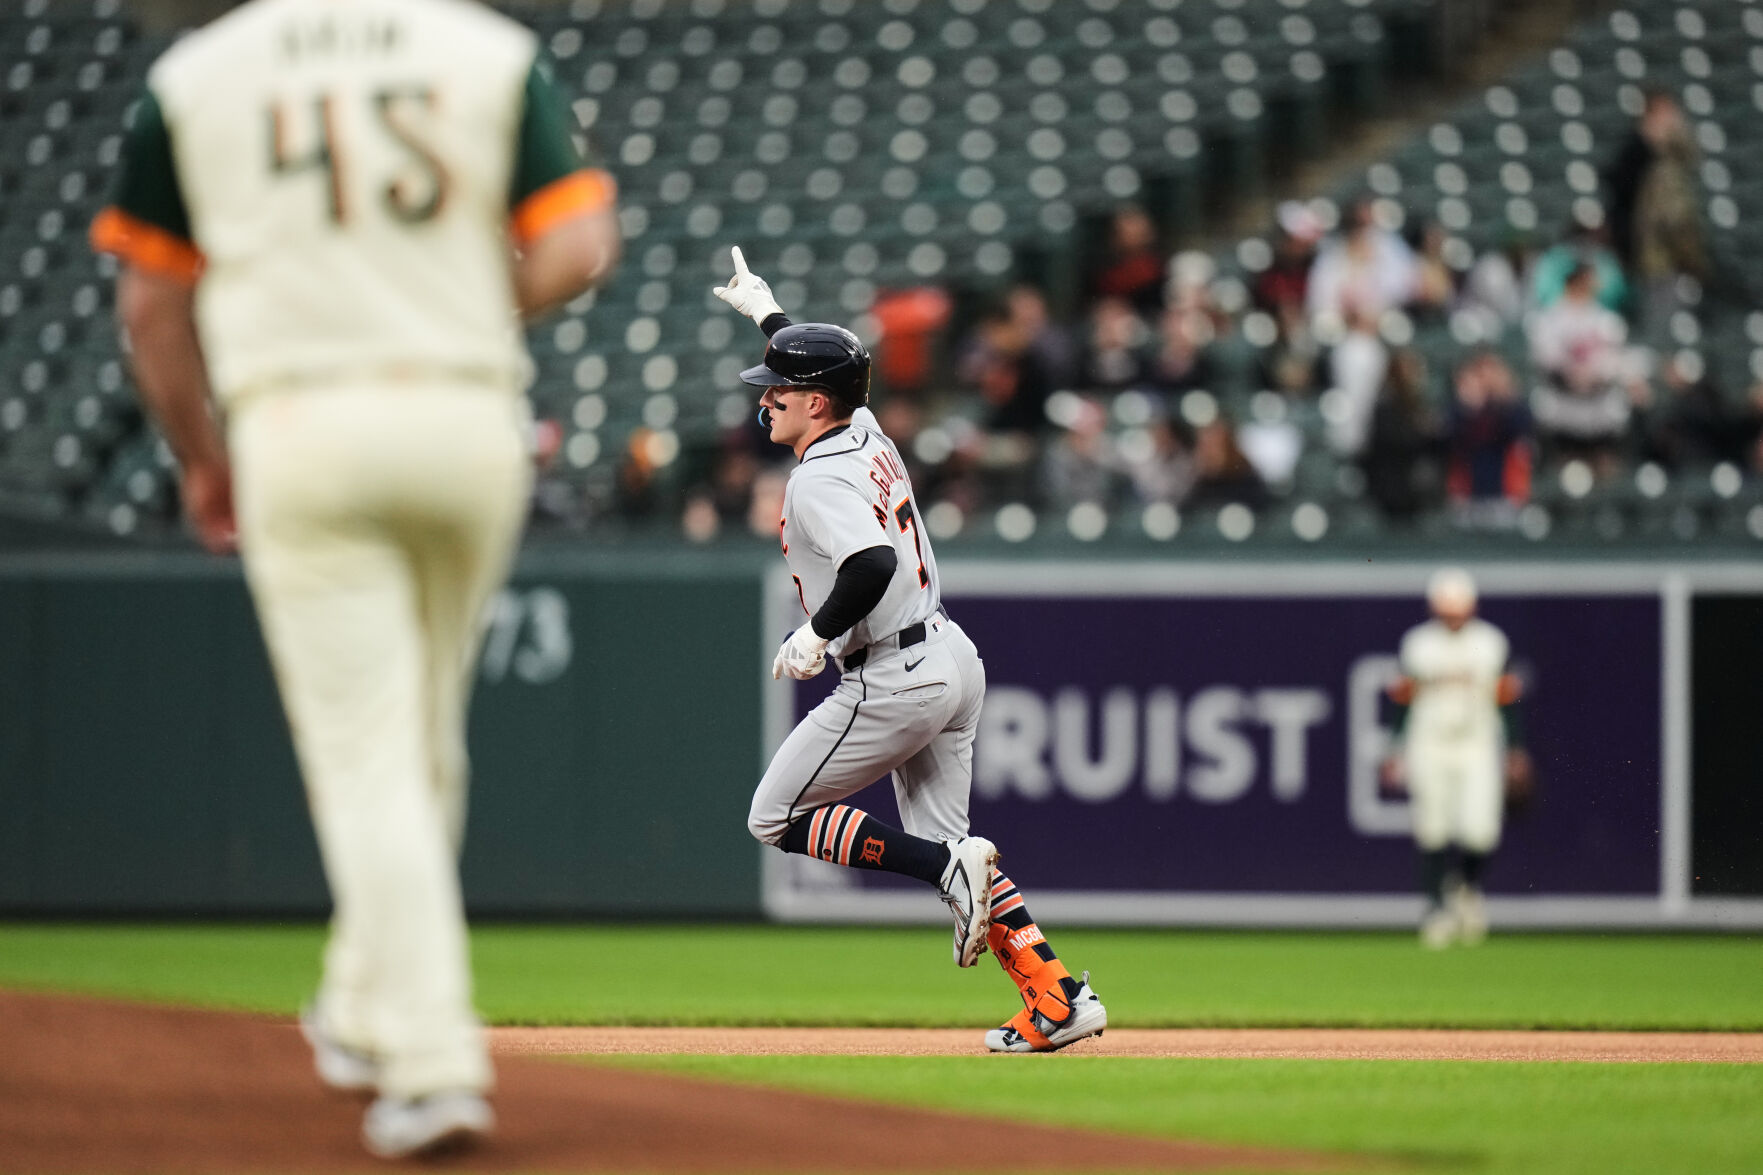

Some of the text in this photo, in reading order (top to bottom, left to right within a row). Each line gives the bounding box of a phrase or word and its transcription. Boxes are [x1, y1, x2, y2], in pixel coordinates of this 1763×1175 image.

[264, 83, 455, 228] 45
[894, 496, 929, 590] 7
[480, 590, 573, 684] 73
[971, 684, 1332, 801] RUIST
